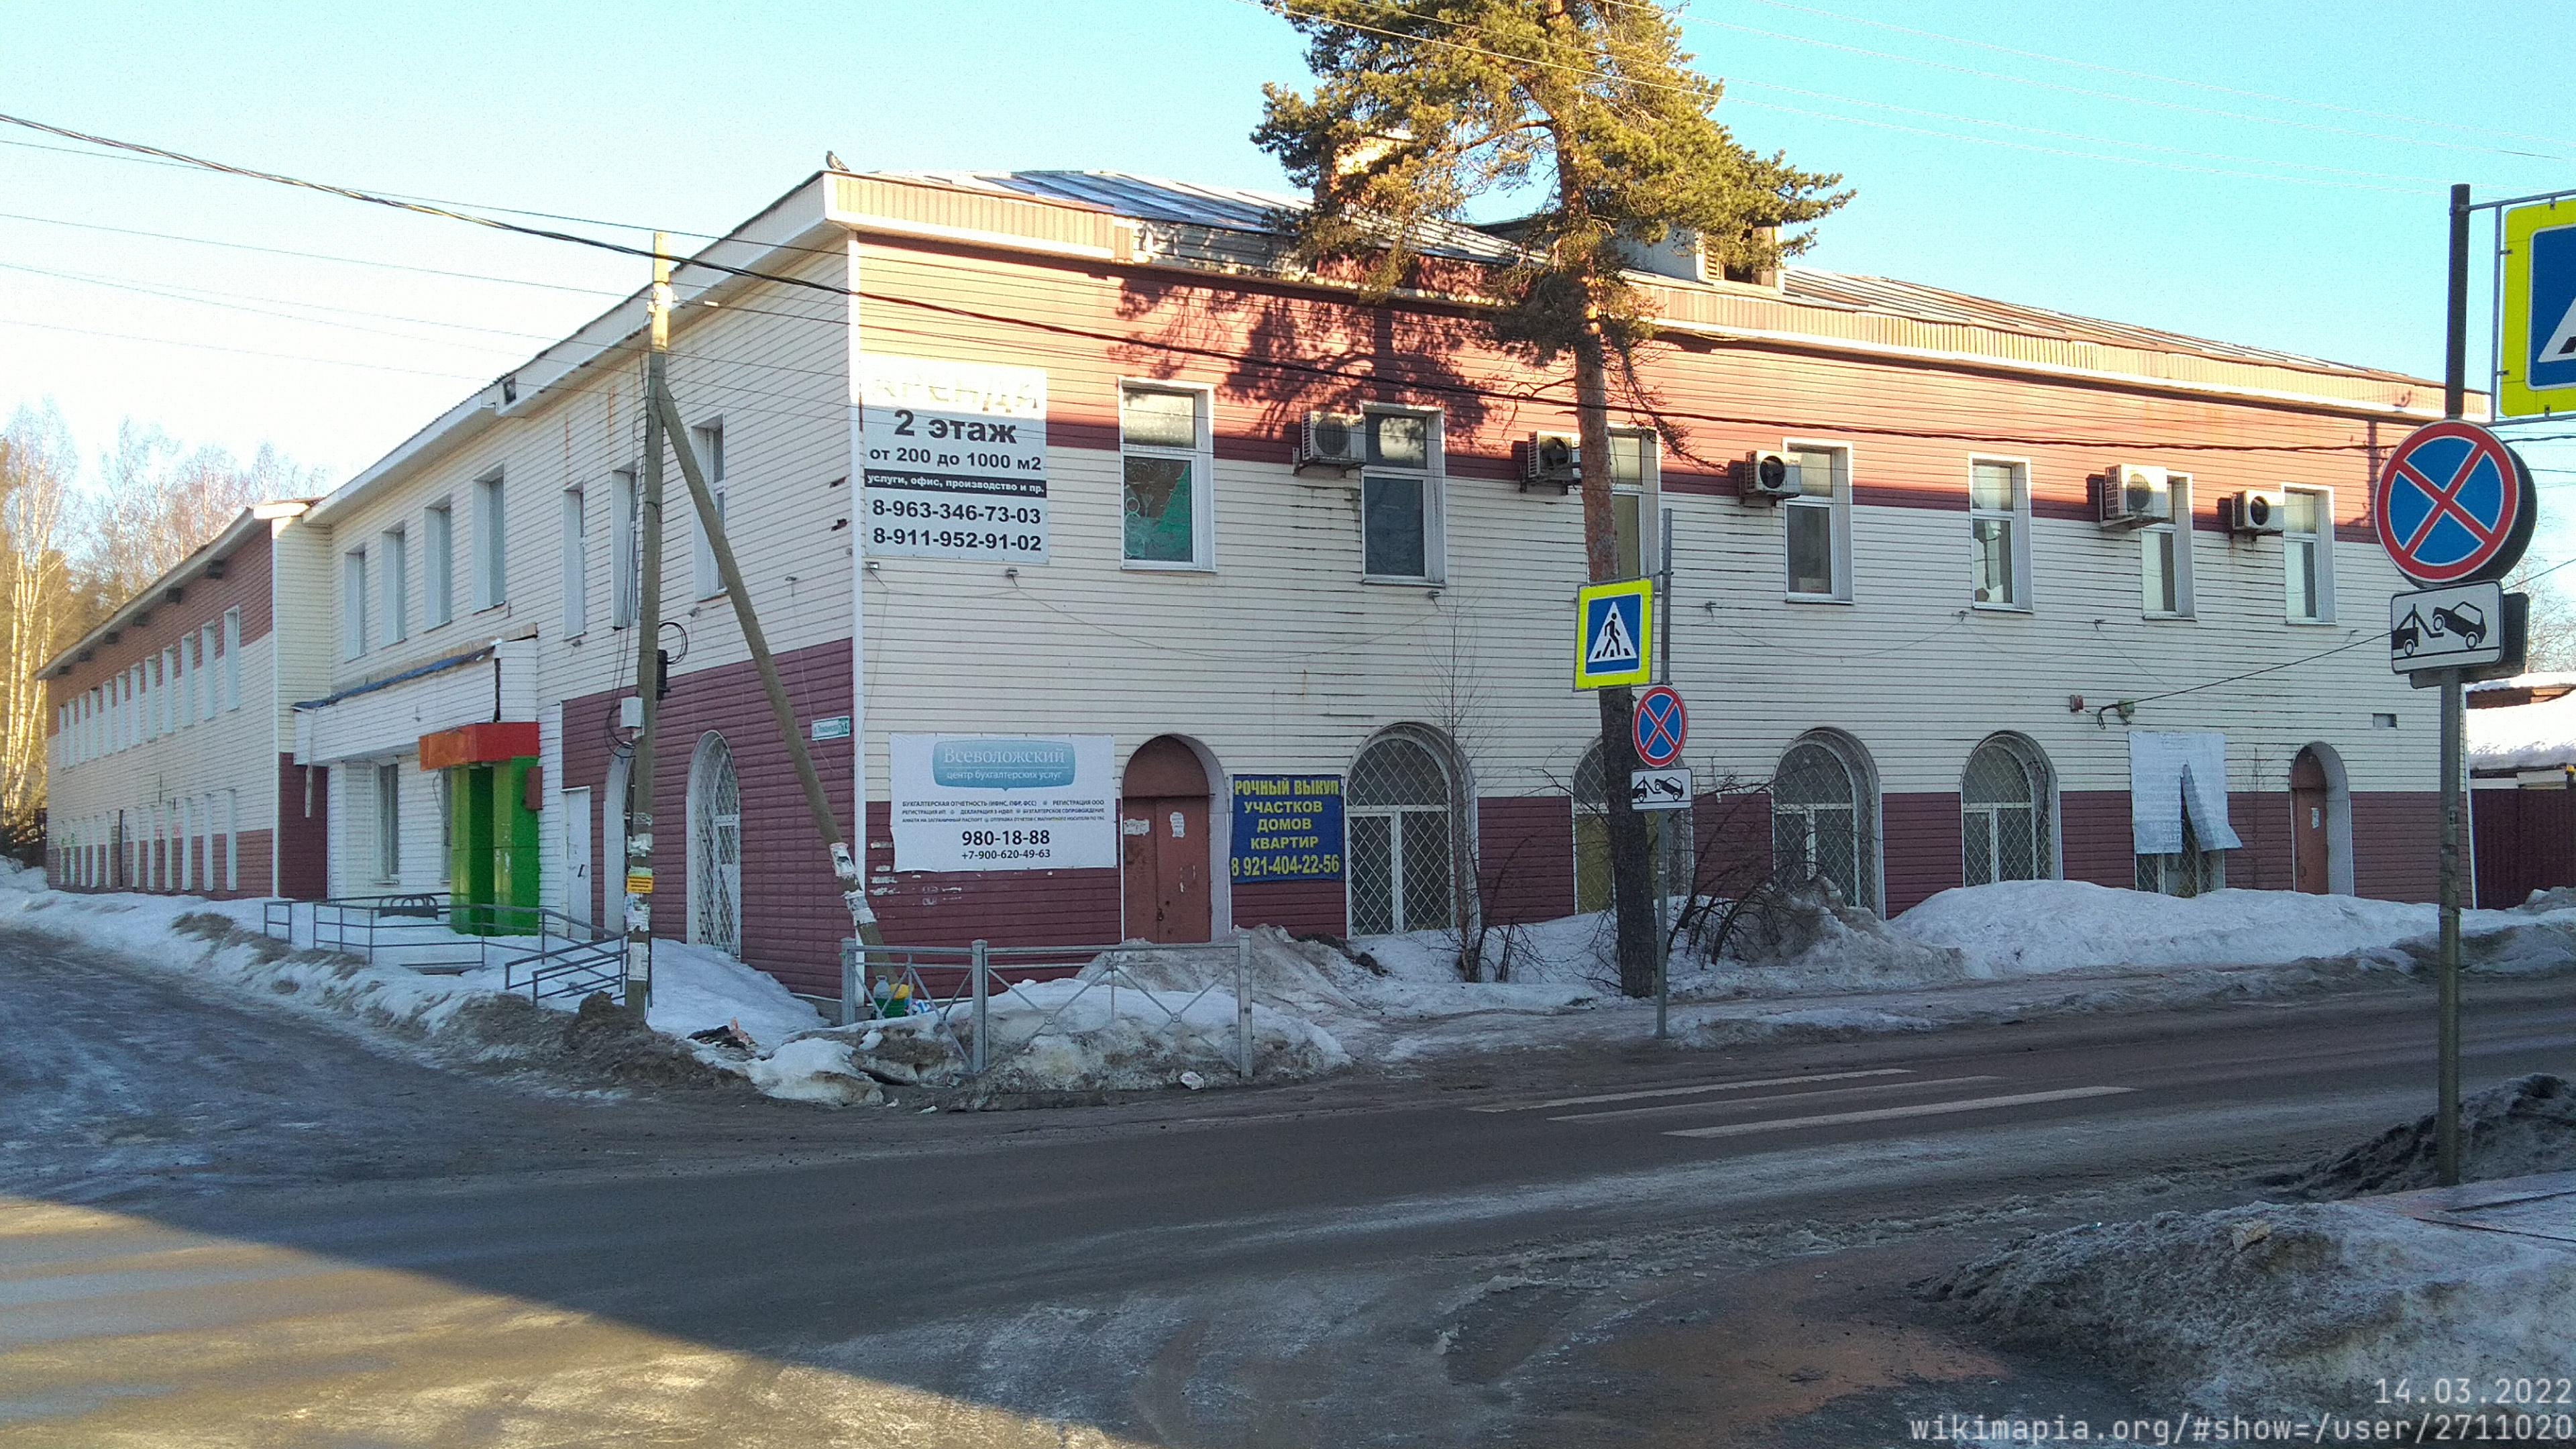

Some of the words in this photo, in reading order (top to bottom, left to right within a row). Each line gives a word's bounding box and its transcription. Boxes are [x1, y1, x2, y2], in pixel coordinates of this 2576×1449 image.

[894, 409, 915, 436] 2
[928, 419, 1017, 443] этаж
[869, 449, 890, 461] от
[896, 447, 930, 463] 200
[937, 453, 959, 467] до
[967, 452, 1010, 469] 1000
[1017, 457, 1041, 470] м2
[867, 474, 908, 486] услуги,
[910, 477, 943, 488] офис,
[946, 480, 1017, 490] производство
[1029, 485, 1044, 494] пр.
[872, 499, 1041, 524] 8-963-346-73-03
[873, 527, 1042, 551] 8-911-952-91-02
[944, 747, 1065, 763] Всеволожский
[947, 771, 973, 780] центр
[975, 769, 1038, 781] бухгалтерских
[1039, 771, 1062, 781] услуг
[1294, 780, 1339, 796] ВЫКУП
[1244, 801, 1323, 814] УЧАСТКОВ
[1257, 818, 1312, 833] ДОМОВ
[961, 830, 1051, 846] 980-18-88
[1250, 837, 1319, 850] КВАРТИР
[961, 849, 1051, 860] +7-900-620-49-63
[1232, 857, 1239, 876] 8
[1244, 854, 1340, 876] 921-404-22-56
